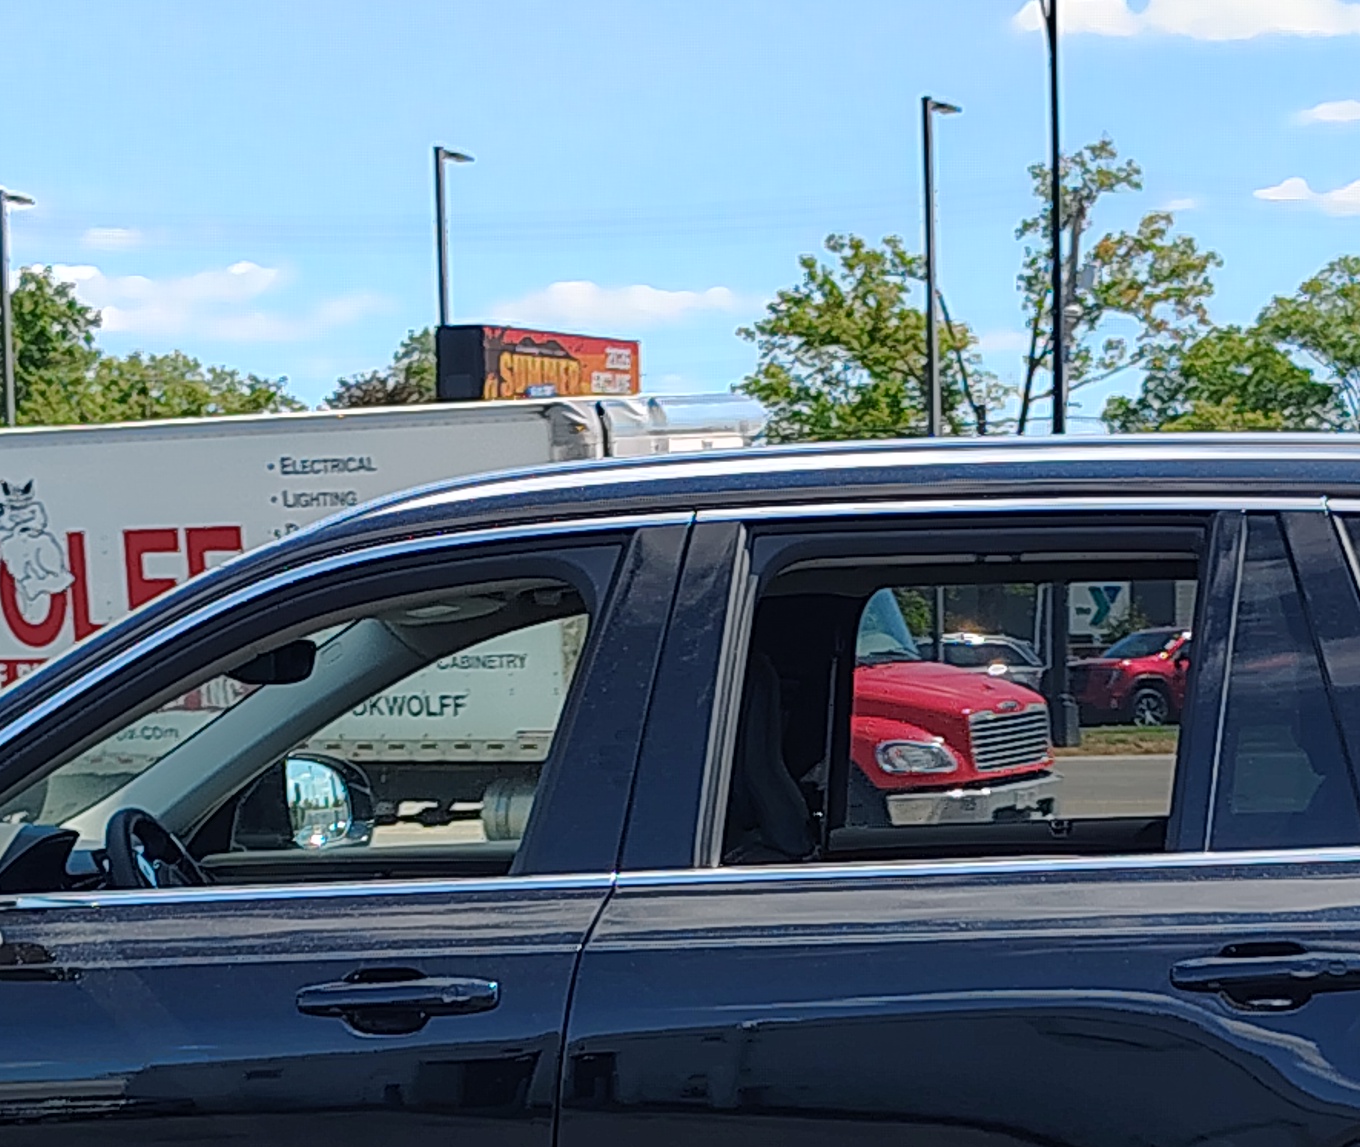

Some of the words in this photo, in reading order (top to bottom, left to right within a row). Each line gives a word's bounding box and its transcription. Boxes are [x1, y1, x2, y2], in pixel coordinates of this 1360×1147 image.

[500, 351, 580, 396] SUMMER
[280, 456, 378, 475] ELECTRICAL
[281, 489, 358, 508] LIGHTING
